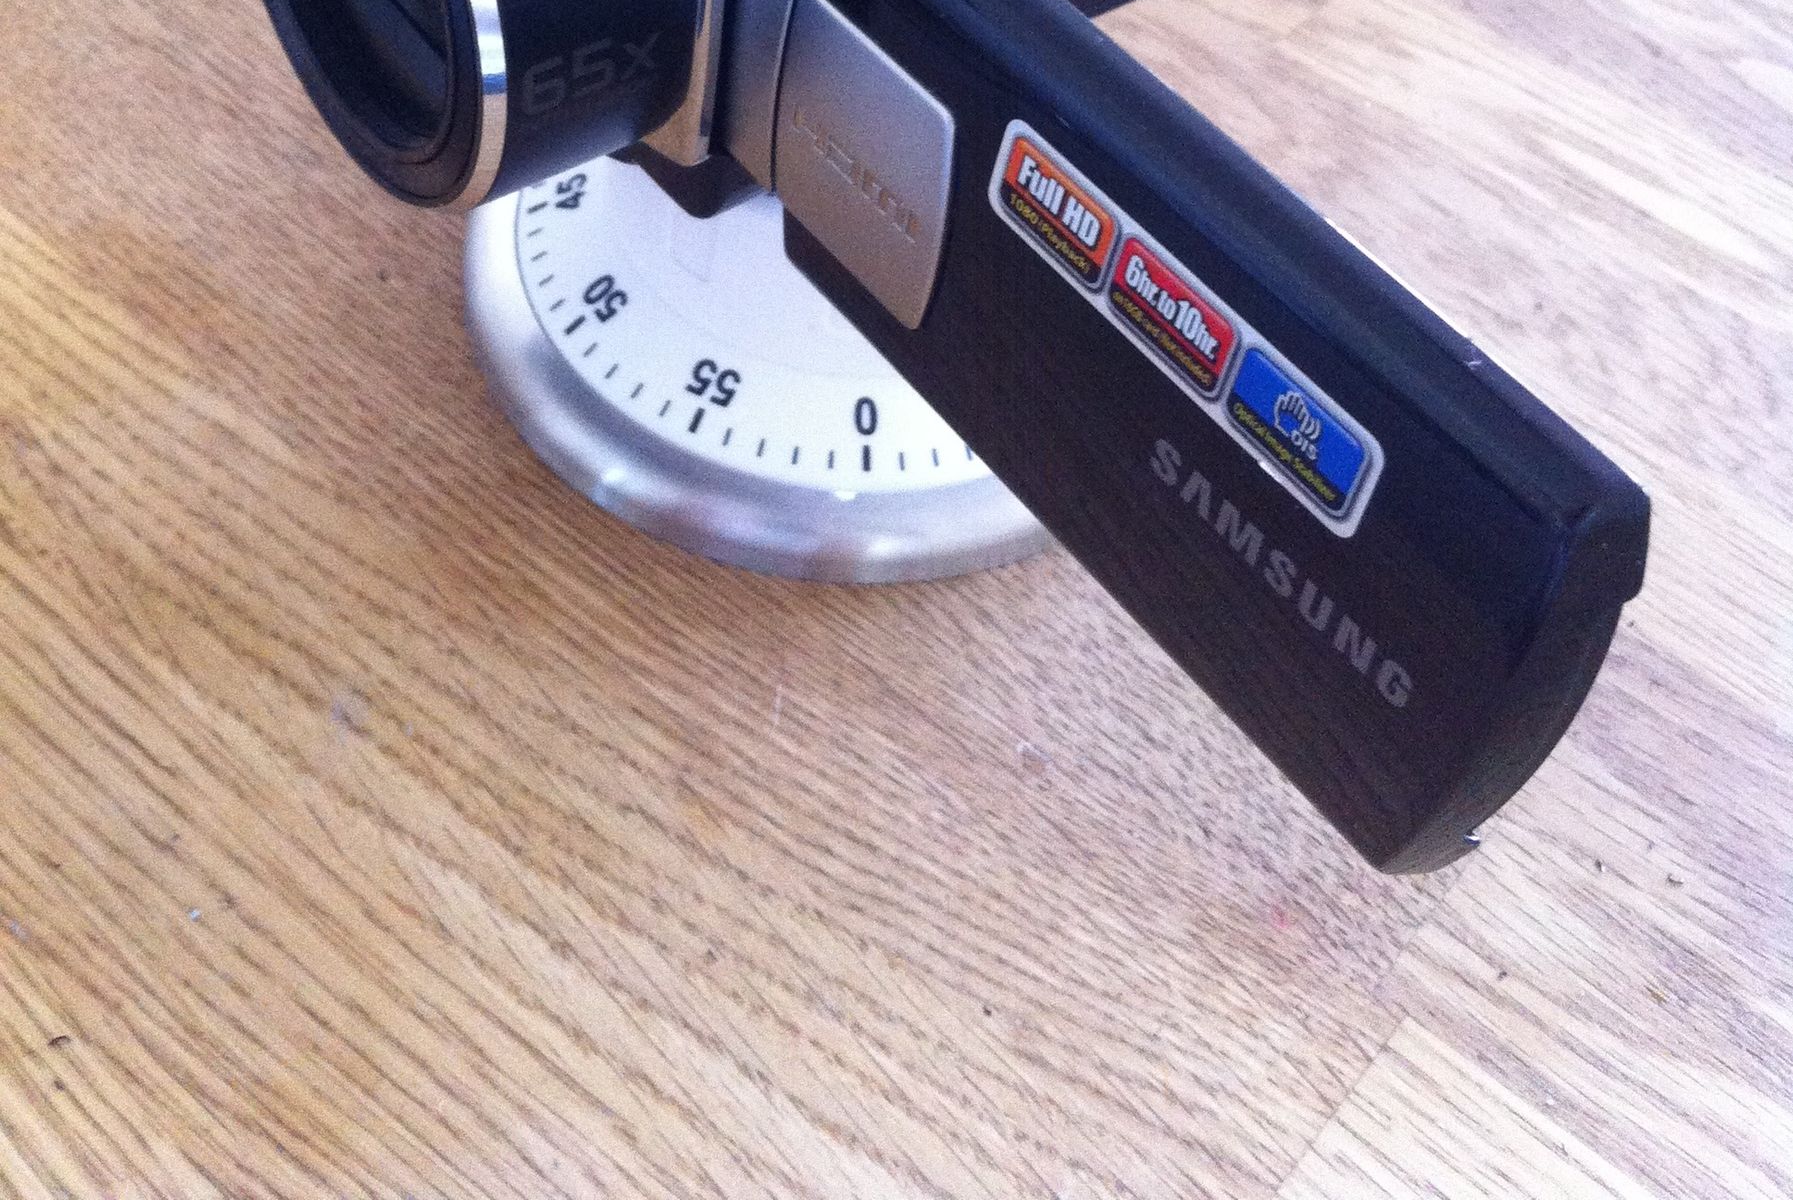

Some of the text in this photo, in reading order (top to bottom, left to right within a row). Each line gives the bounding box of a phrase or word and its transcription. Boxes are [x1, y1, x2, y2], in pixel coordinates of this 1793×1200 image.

[554, 173, 588, 210] 45
[1017, 155, 1101, 247] Full HD
[582, 274, 628, 323] 50
[685, 358, 741, 408] 55
[854, 397, 878, 436] 0
[1290, 429, 1318, 460] OIS
[1149, 438, 1414, 708] SAMSUNG
